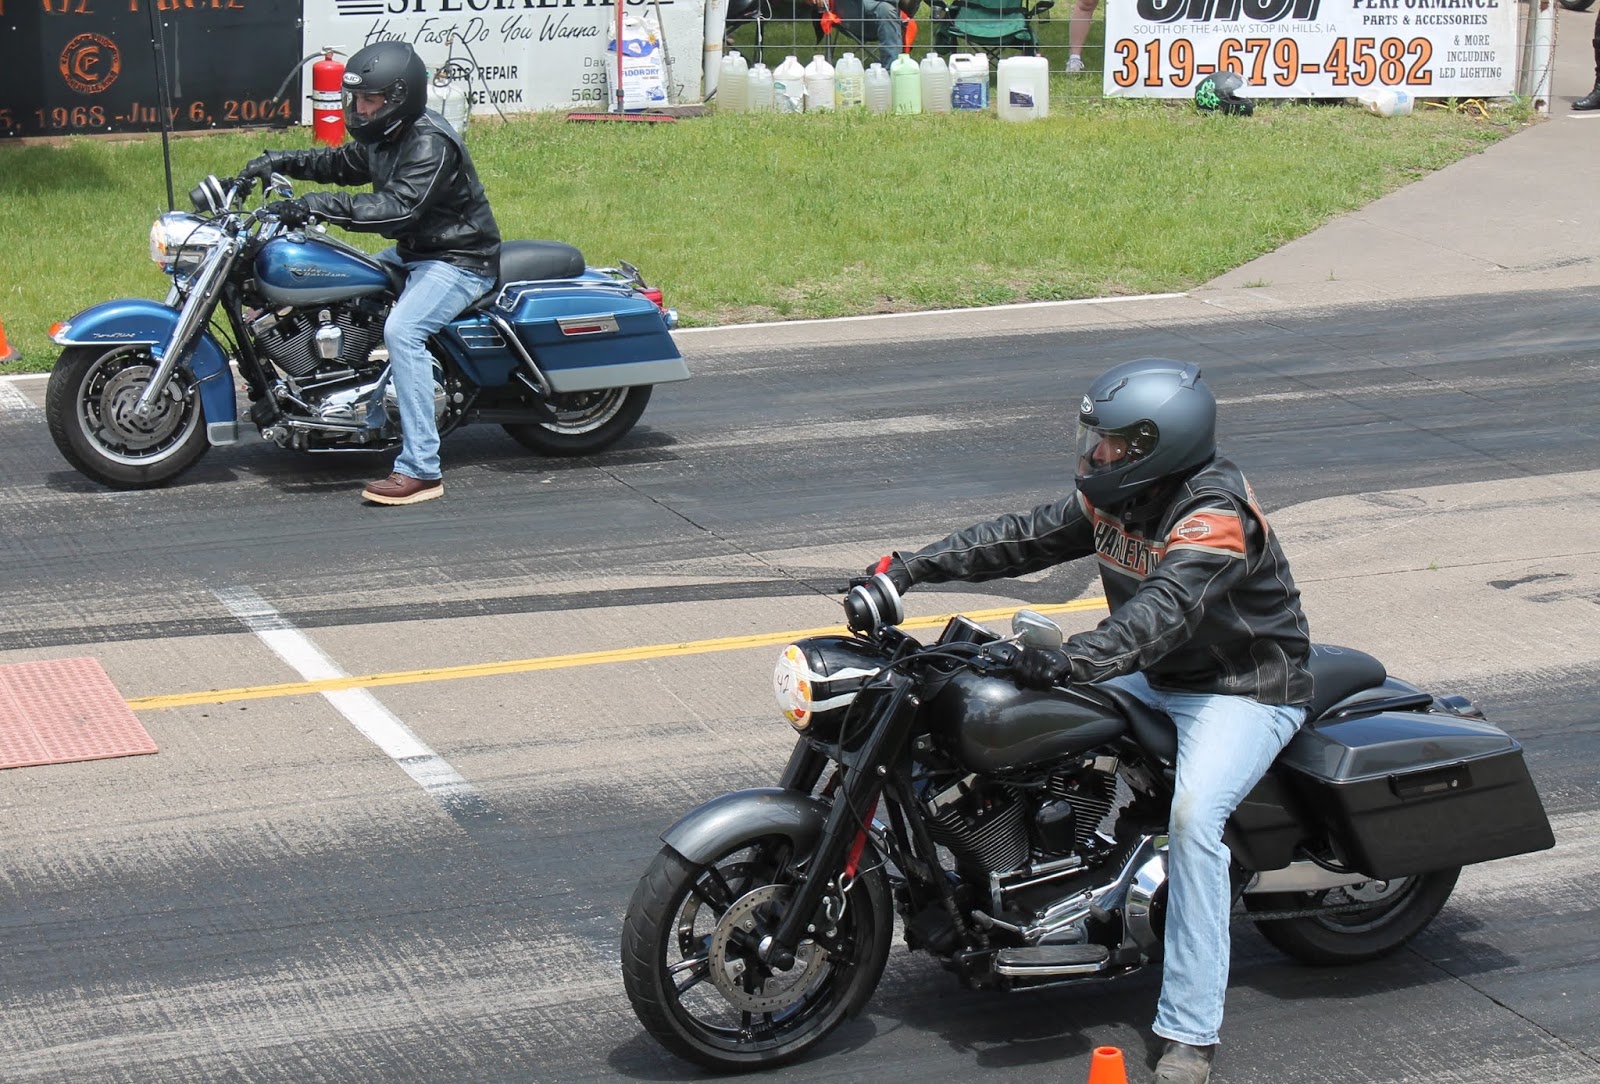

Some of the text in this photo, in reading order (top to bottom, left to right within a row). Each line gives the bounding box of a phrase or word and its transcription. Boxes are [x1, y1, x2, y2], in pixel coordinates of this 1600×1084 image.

[1362, 14, 1488, 26] PARTS & ACCESSORIES
[364, 18, 407, 48] How
[413, 17, 460, 45] Fast
[462, 17, 490, 44] Do
[500, 15, 533, 43] You
[538, 13, 600, 43] Wanna
[1133, 24, 1337, 35] SOUTH OF THE 4-WAY STOP IN HILLS, IA
[1453, 34, 1490, 46] & MORE
[1113, 37, 1433, 87] 319-679-4582
[1447, 51, 1496, 62] INCLUDING
[436, 65, 518, 84] RTS, REPAIR
[621, 69, 645, 77] LOOR
[1439, 67, 1502, 79] LED LIGHTING
[489, 89, 523, 104] WORK
[35, 105, 106, 128] 1968
[115, 102, 179, 123] -Juy
[189, 101, 213, 124] 6,
[224, 98, 291, 121] 2004
